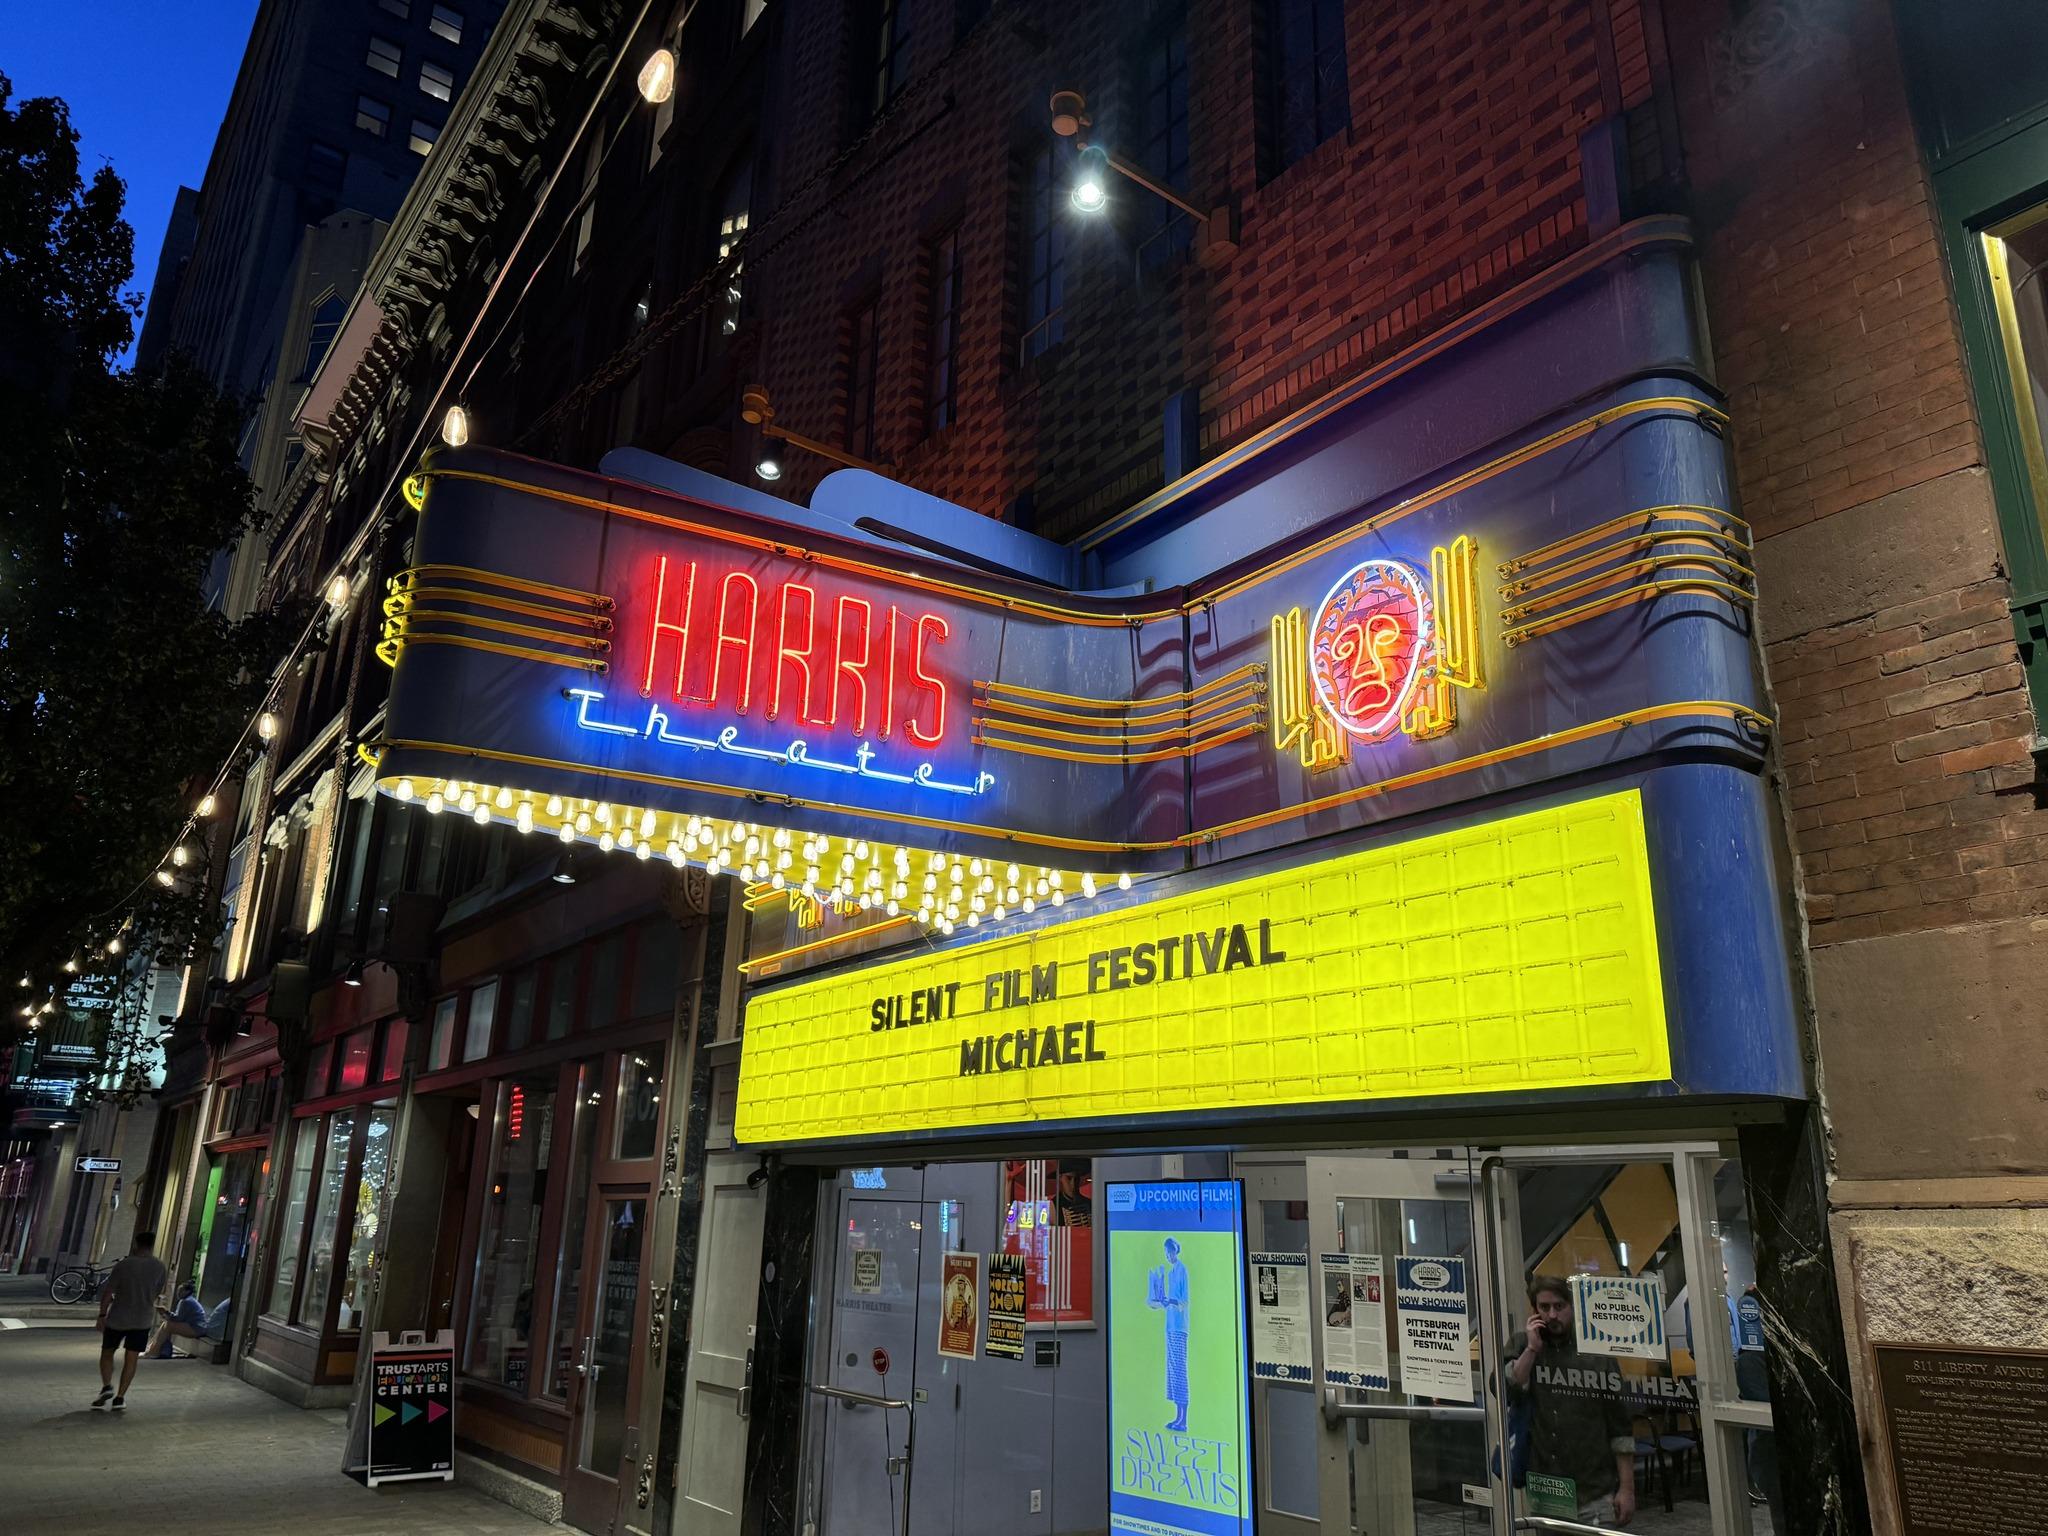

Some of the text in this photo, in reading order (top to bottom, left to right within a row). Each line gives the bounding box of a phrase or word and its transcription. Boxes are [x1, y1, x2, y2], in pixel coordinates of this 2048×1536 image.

[638, 556, 951, 749] HARRIS
[568, 688, 995, 796] Theater
[870, 918, 1287, 1032] SILENT FILM FESTIVAL
[959, 1020, 1107, 1077] MICHAEL
[1139, 1188, 1234, 1202] UPCOMING FILMS
[1251, 1253, 1307, 1264] NOW SHOWING
[989, 1278, 1025, 1293] HORROR
[989, 1291, 1025, 1311] SHOW
[1398, 1295, 1466, 1309] NOW SHOWING
[1594, 1302, 1641, 1313] NO PUBLIC
[1406, 1318, 1460, 1330] PITTSBURGH
[1592, 1312, 1645, 1322] RESTROOMS
[1407, 1329, 1460, 1341] SILENT FILM
[1413, 1340, 1454, 1351] FESTIVAL
[377, 1362, 449, 1376] TRUSTARTS
[1913, 1360, 2045, 1379] 811 LIBERTY AVENUE
[1535, 1365, 1622, 1392] HARRIS
[1905, 1374, 1965, 1386] PENN-LIBERTY
[1969, 1378, 2012, 1391] HISTORIC
[377, 1383, 448, 1396] CENTER
[1666, 1401, 1700, 1409] CULTURA
[1126, 1427, 1231, 1474] SWEET
[1120, 1456, 1238, 1508] DREAMS
[1528, 1475, 1564, 1488] INSPECTED
[1529, 1483, 1564, 1496] PERMITTED
[1123, 1519, 1150, 1532] SHOWTIMES
